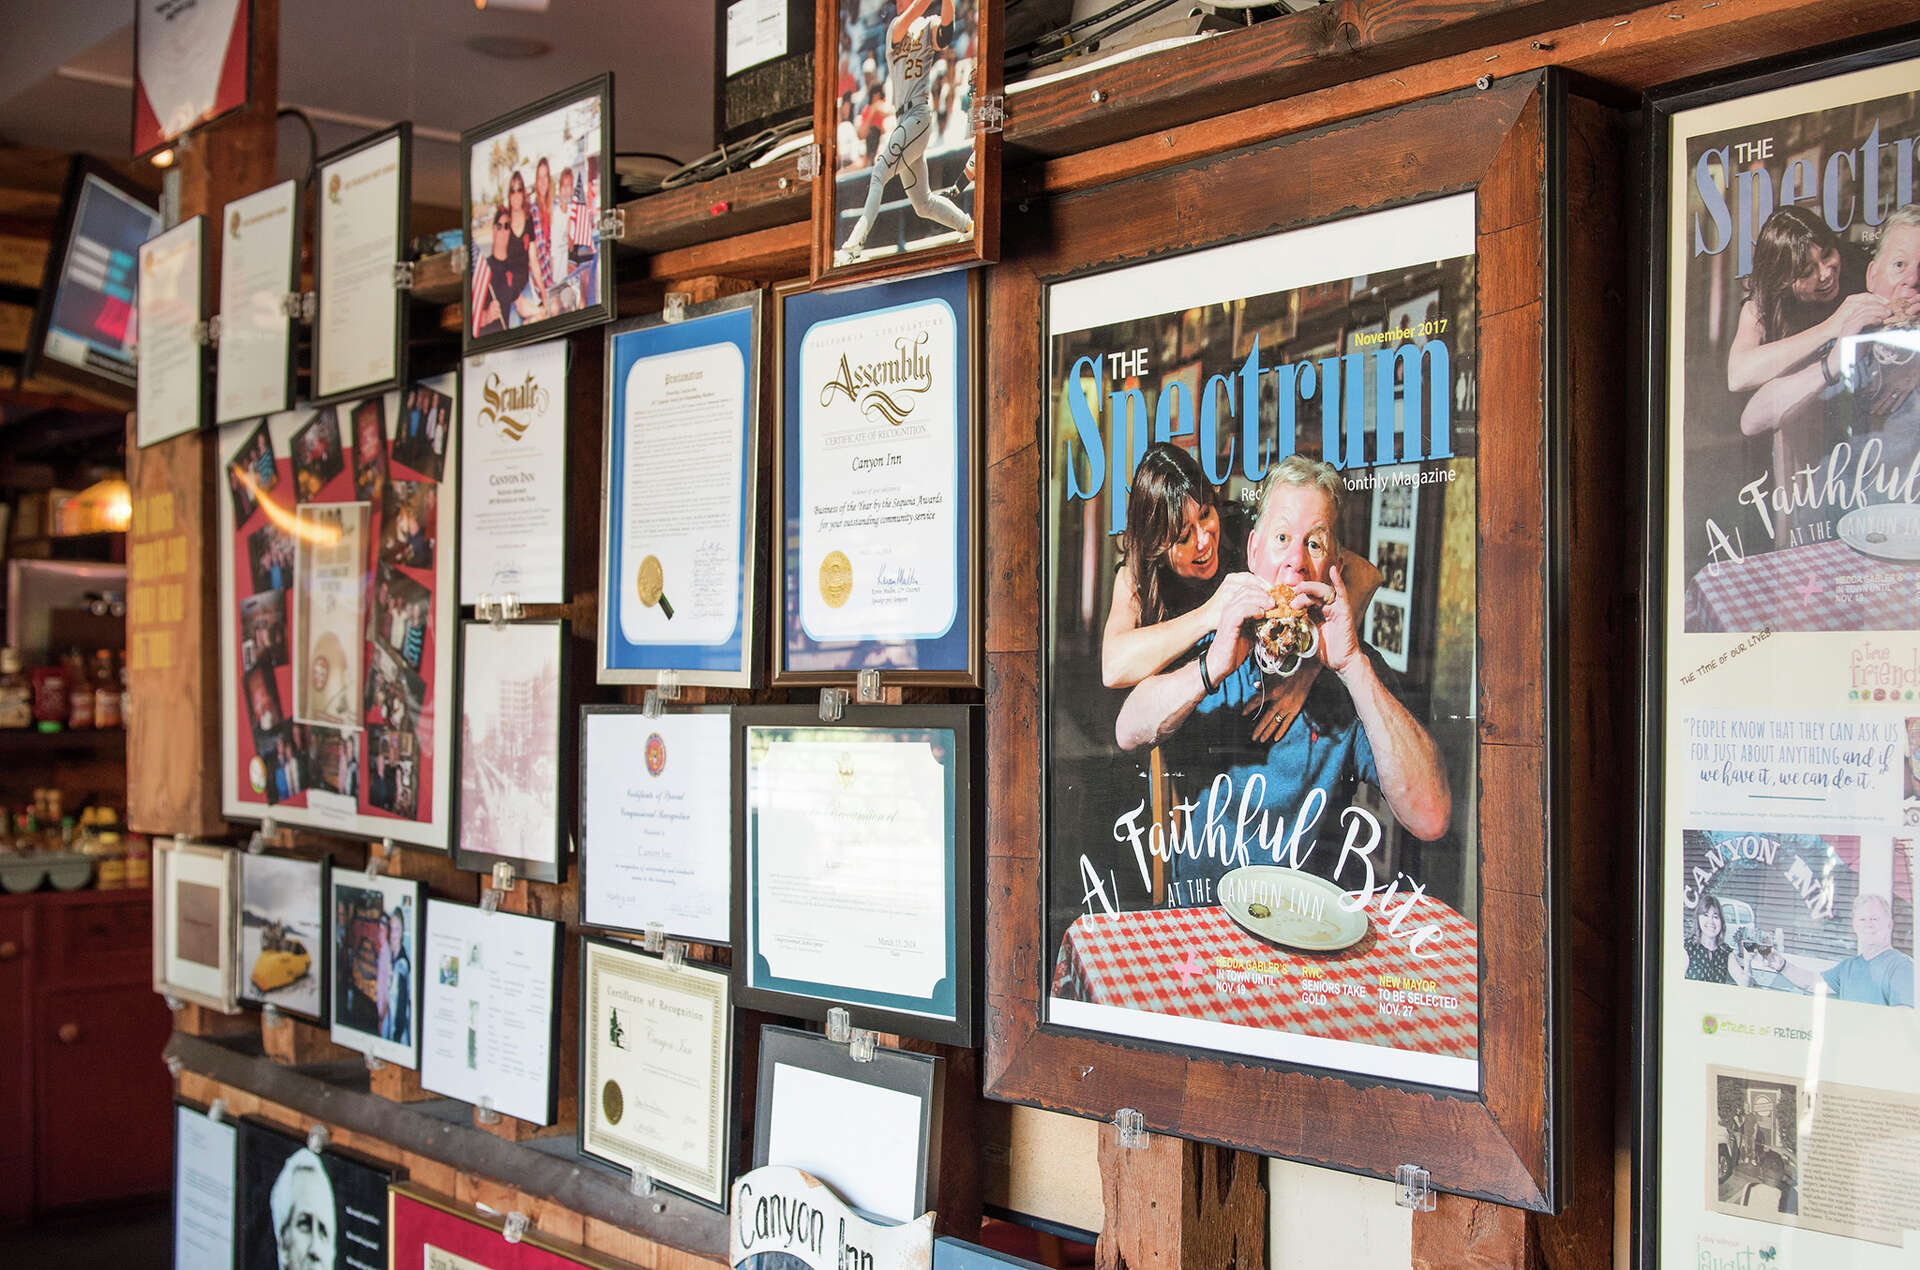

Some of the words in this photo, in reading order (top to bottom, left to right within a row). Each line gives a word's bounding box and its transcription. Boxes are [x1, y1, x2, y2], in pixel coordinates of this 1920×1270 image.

[904, 59, 922, 80] 25
[1734, 137, 1774, 164] THE
[1354, 326, 1415, 347] November
[1418, 319, 1448, 338] 2017
[820, 331, 932, 407] Assembly
[1108, 348, 1149, 380] THE
[852, 456, 884, 472] Canyon
[886, 453, 902, 467] Inn
[1343, 471, 1387, 493] onthly
[1391, 468, 1456, 490] Magazine
[1790, 528, 1804, 548] AT
[1808, 519, 1832, 543] THE
[1706, 518, 1744, 577] A
[1680, 672, 1696, 686] THE
[1719, 651, 1728, 666] OF
[1731, 643, 1748, 658] OUR
[1849, 648, 1920, 688] friend
[1730, 721, 1765, 740] KNOW
[1770, 720, 1794, 740] THAT
[1798, 721, 1825, 741] THEY
[1829, 722, 1853, 741] CAN
[1858, 722, 1880, 742] ASK
[1884, 722, 1898, 742] US
[1690, 743, 1709, 761] FOR
[1712, 744, 1736, 763] JUST
[1741, 744, 1774, 764] ABOUT
[1778, 745, 1840, 766] ANYTHING
[1843, 747, 1874, 768] and
[1878, 744, 1895, 768] if
[1700, 768, 1719, 785] we
[1722, 760, 1755, 786] have
[1779, 771, 1801, 785] we
[1802, 771, 1828, 788] can
[1832, 768, 1853, 789] do
[1079, 853, 1120, 933] A
[1113, 773, 1327, 893] Faithful
[1333, 806, 1444, 959] Bite
[1683, 836, 1781, 909] CANYON
[1168, 882, 1184, 908] AT
[1187, 878, 1213, 904] THE
[1218, 876, 1282, 909] CANYON
[1288, 886, 1328, 922] INN
[1216, 956, 1245, 971] HEDDA
[1302, 966, 1322, 980] RWC
[1216, 969, 1224, 980] IN
[1225, 970, 1250, 984] TOWN
[1252, 972, 1276, 987] UNTIL
[1216, 982, 1235, 995] NOV.
[1237, 984, 1246, 996] 19
[1302, 979, 1340, 996] SENIORS
[1342, 984, 1366, 998] TAKE
[1379, 975, 1401, 990] NEW
[1403, 977, 1437, 994] MAYOR
[1302, 992, 1327, 1007] GOLD
[1378, 987, 1390, 1001] TO
[1392, 989, 1405, 1003] BE
[1407, 992, 1458, 1010] SELECTED
[1379, 1002, 1401, 1017] NOV.
[1402, 1004, 1414, 1018] 27
[738, 1183, 824, 1256] Canyon
[838, 1217, 874, 1270] Inn
